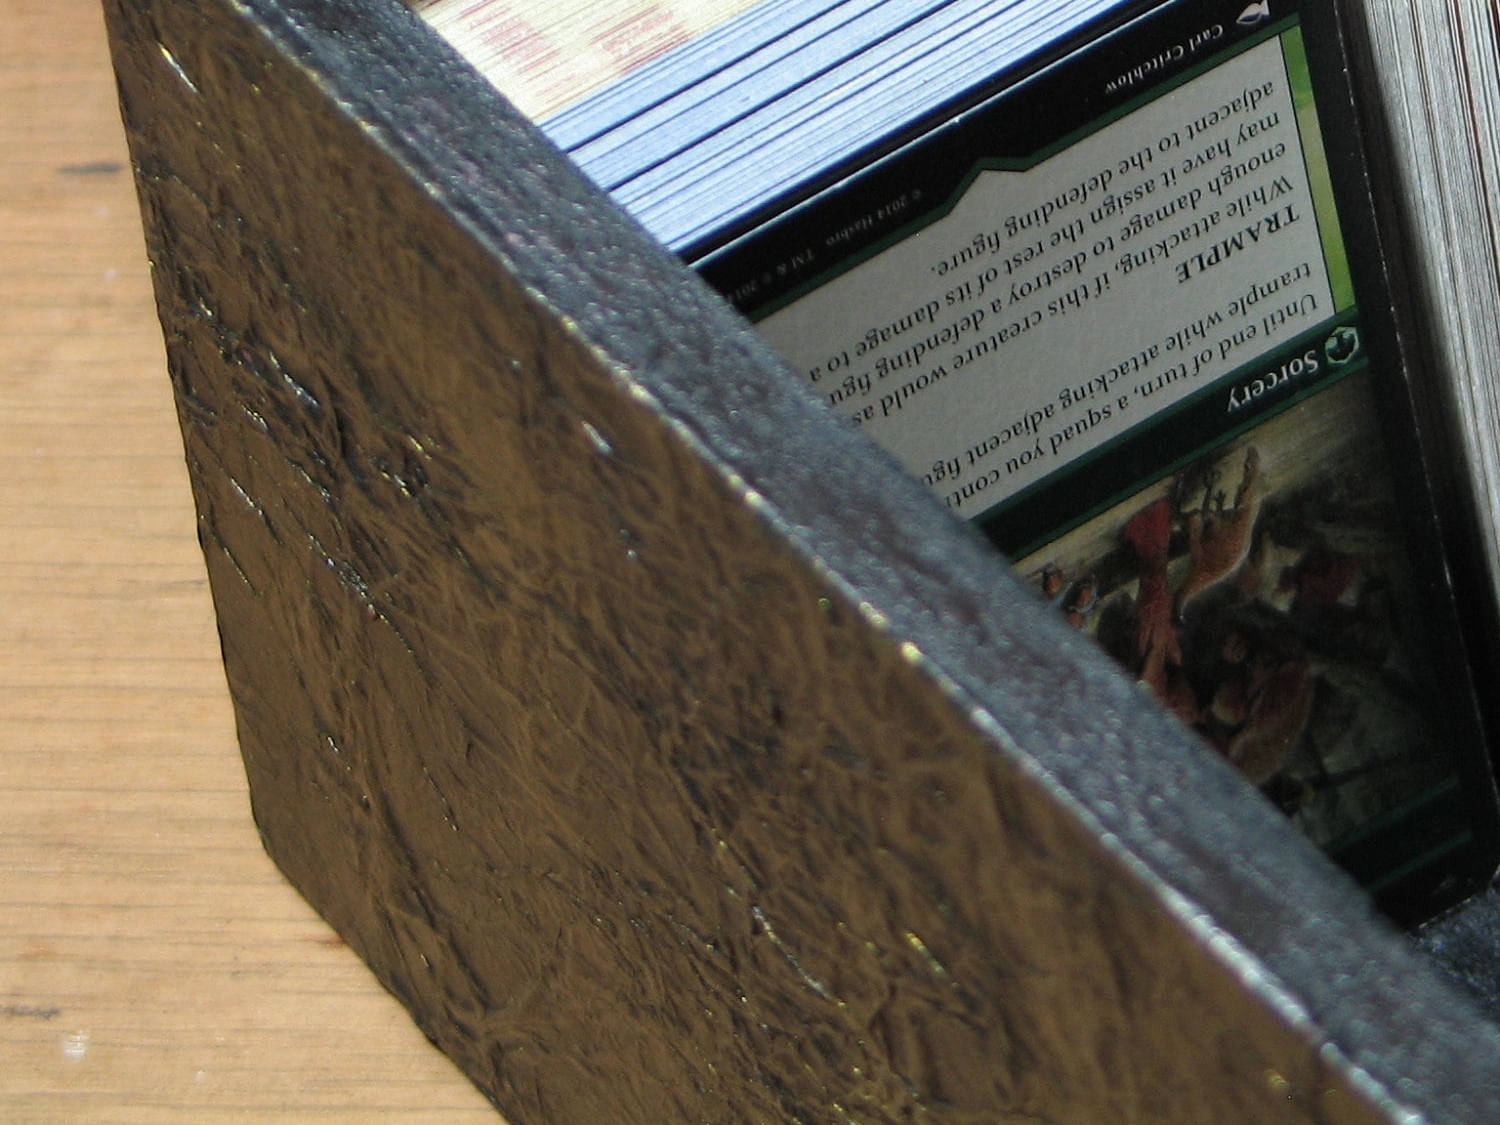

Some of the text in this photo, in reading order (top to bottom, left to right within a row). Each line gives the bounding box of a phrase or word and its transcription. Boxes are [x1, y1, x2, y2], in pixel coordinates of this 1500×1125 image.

[1105, 23, 1224, 91] Carl Critchlow
[1235, 110, 1280, 146] may
[1181, 137, 1232, 174] have
[929, 80, 1273, 277] adjacent to the defending figure.
[1161, 166, 1177, 188] it
[1088, 177, 1155, 225] assign
[1049, 217, 1085, 247] the
[1174, 203, 1300, 284] TRAMPLE
[828, 141, 1286, 406] enough damage to destroy a defending figu
[1003, 239, 1045, 276] rest
[943, 280, 972, 306] its
[976, 266, 999, 293] of
[850, 174, 1294, 425] While attacking, if this creature would as
[1261, 292, 1318, 337] Until
[854, 299, 940, 357] damage
[1217, 323, 1257, 361] end
[825, 350, 850, 373] to
[924, 261, 1311, 486] trample while attacking adjacent figu
[1132, 362, 1188, 398] turn,
[1192, 348, 1213, 375] of
[1226, 348, 1319, 412] Sorcery
[1116, 394, 1129, 411] a
[1048, 406, 1112, 456] squad
[1004, 436, 1045, 475] you
